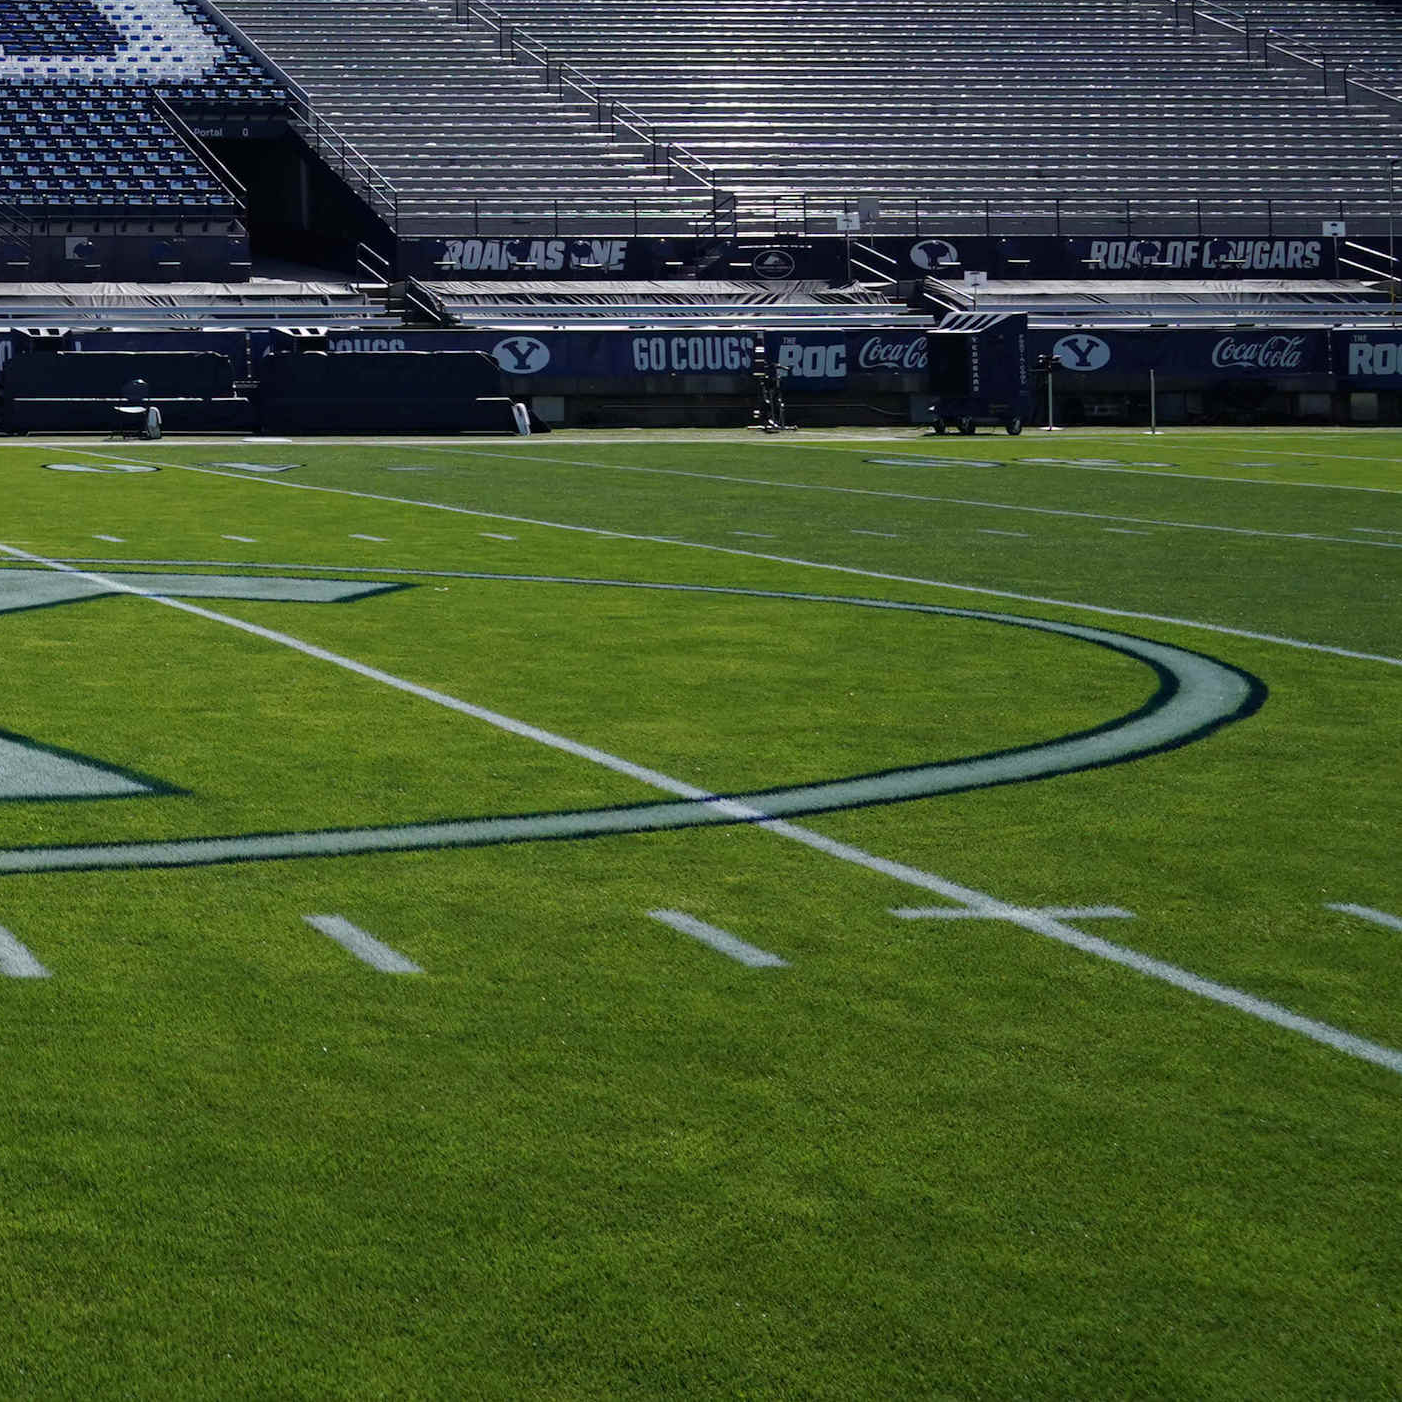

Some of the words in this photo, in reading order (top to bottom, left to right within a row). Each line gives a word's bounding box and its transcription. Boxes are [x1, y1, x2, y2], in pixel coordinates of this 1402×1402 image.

[525, 239, 566, 270] AS
[1165, 240, 1201, 269] OF
[632, 337, 666, 371] GO
[670, 336, 754, 371] COUGS
[1212, 335, 1302, 368] Coca-Cola
[1353, 334, 1367, 343] THE
[779, 344, 847, 377] ROC
